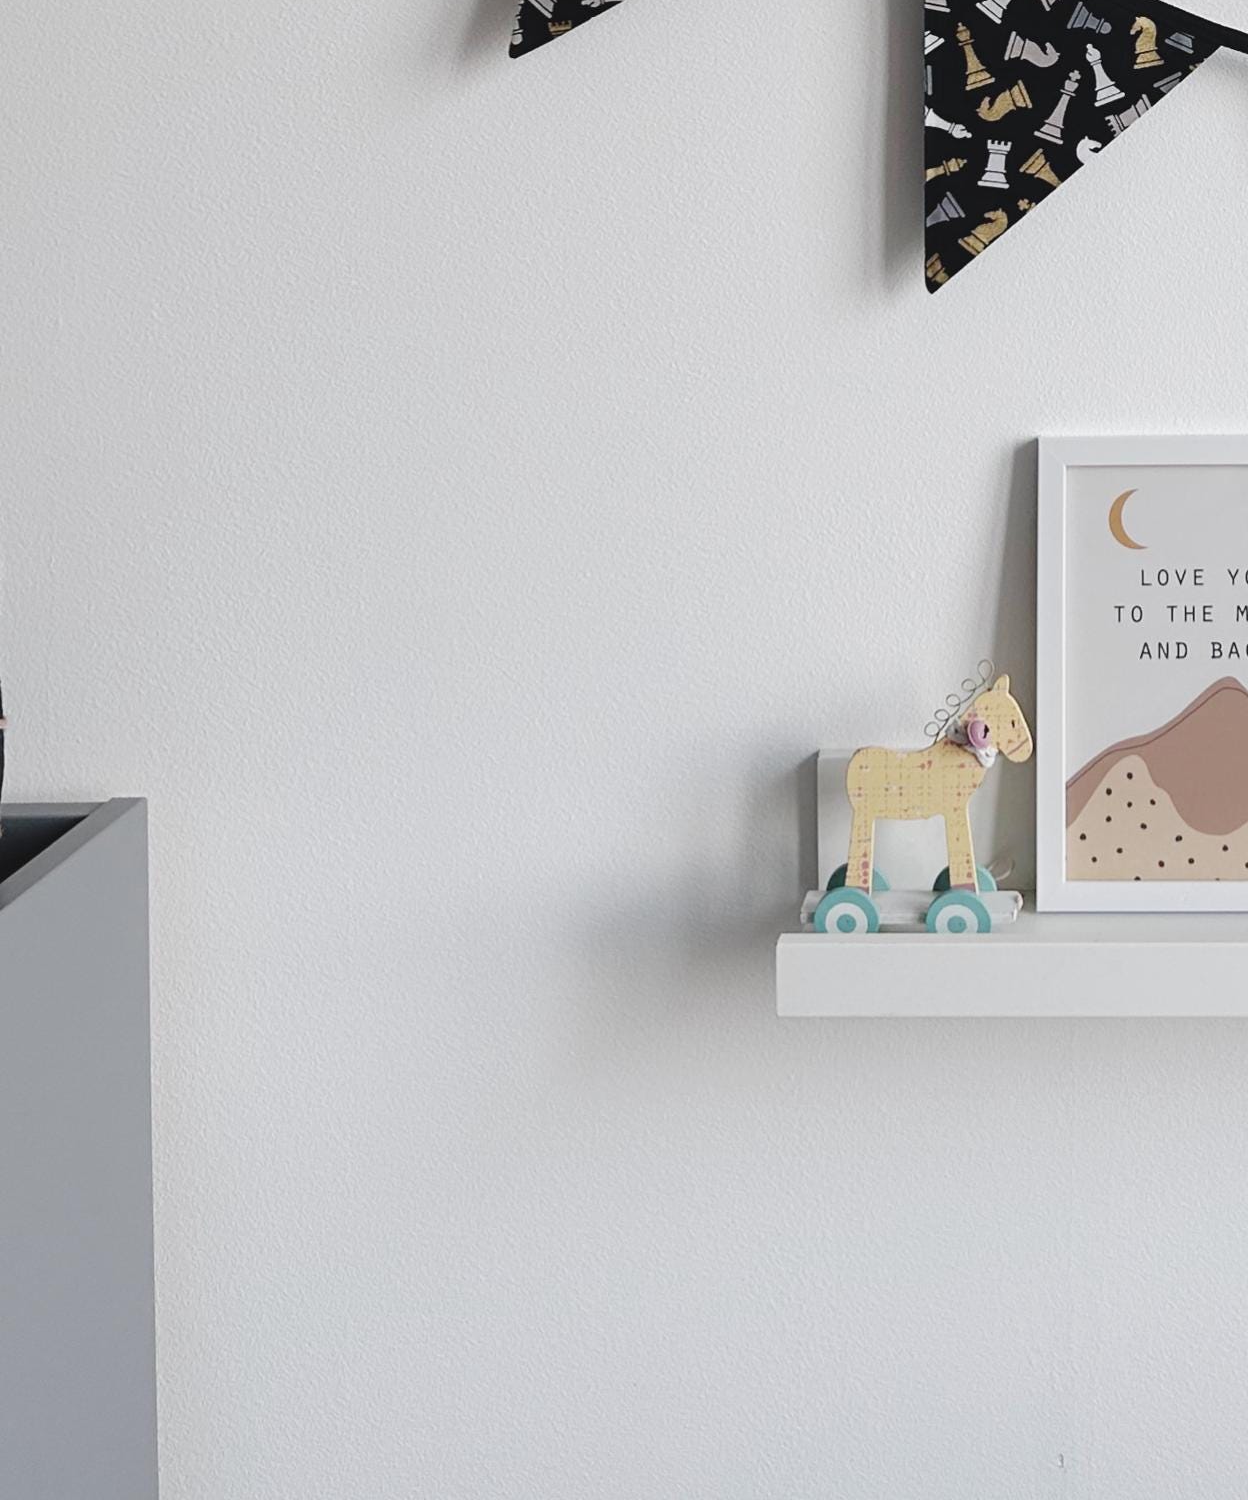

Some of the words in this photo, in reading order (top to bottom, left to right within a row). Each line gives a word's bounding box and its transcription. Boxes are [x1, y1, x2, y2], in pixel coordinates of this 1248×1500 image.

[1140, 568, 1205, 587] LOVE
[1113, 604, 1144, 623] TO
[1166, 604, 1214, 623] THE
[1138, 641, 1189, 660] AND
